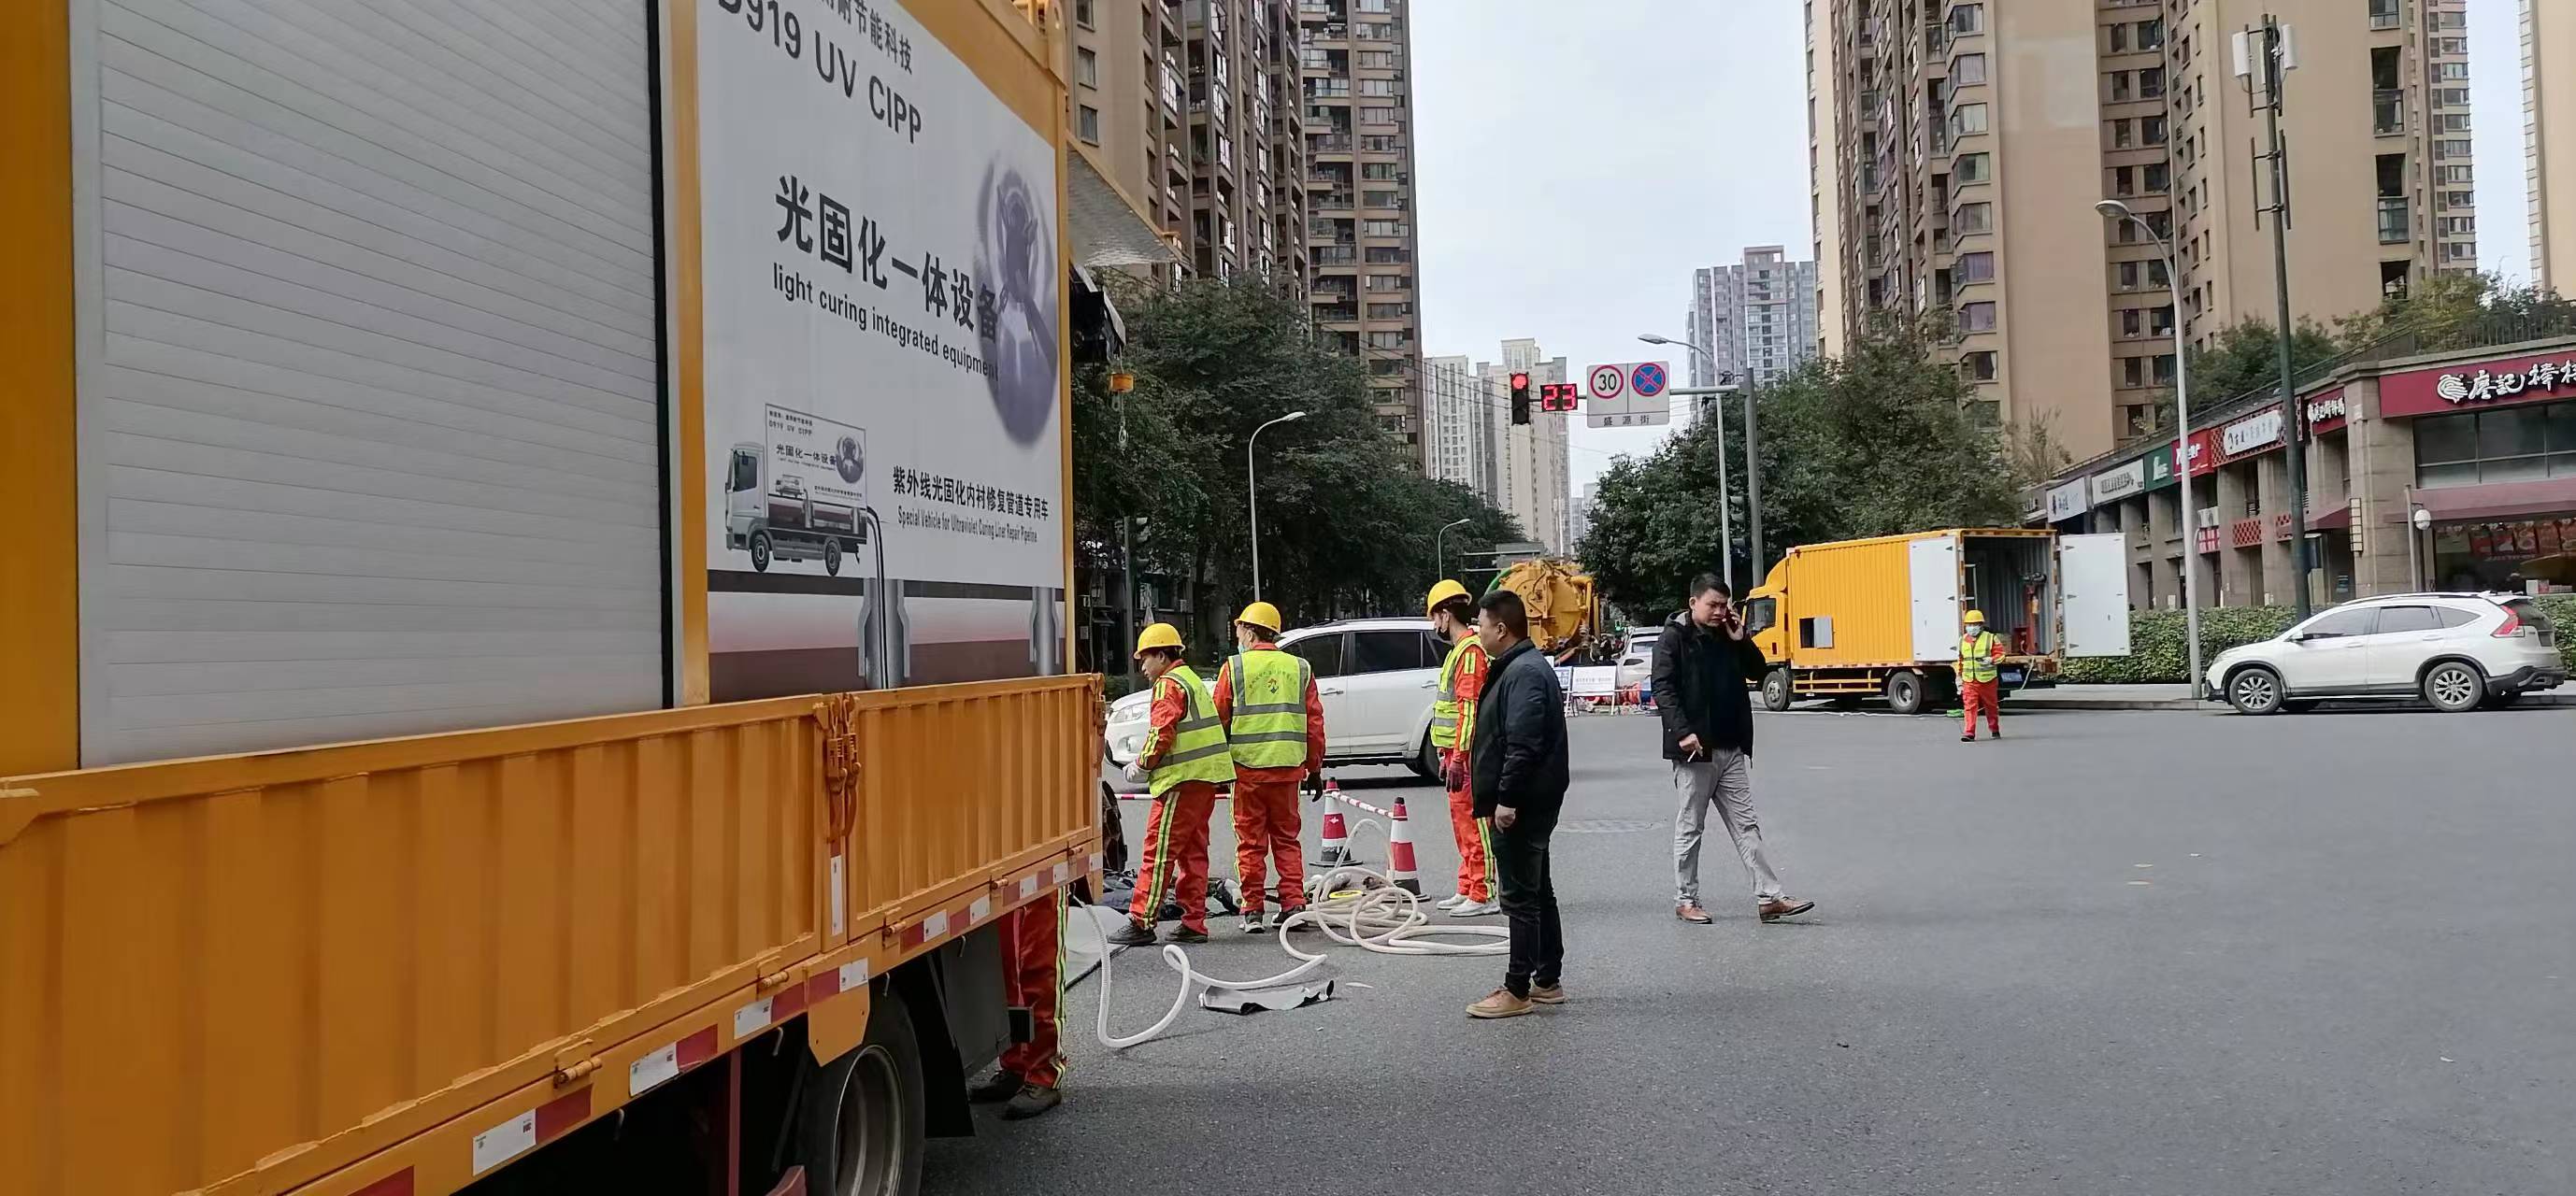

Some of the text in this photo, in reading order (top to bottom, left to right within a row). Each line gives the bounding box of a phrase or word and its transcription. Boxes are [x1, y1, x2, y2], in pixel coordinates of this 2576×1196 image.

[719, 0, 922, 144] 919 UV CIPP
[775, 175, 998, 344] 光固化一体设备
[773, 262, 813, 304] light
[820, 286, 867, 332] curing
[872, 306, 938, 357] integrated
[1543, 385, 1575, 411] 23
[1598, 373, 1617, 392] 30
[894, 465, 1049, 521] 紫外线光固化内衬修复管道专用车
[897, 505, 920, 529] Special
